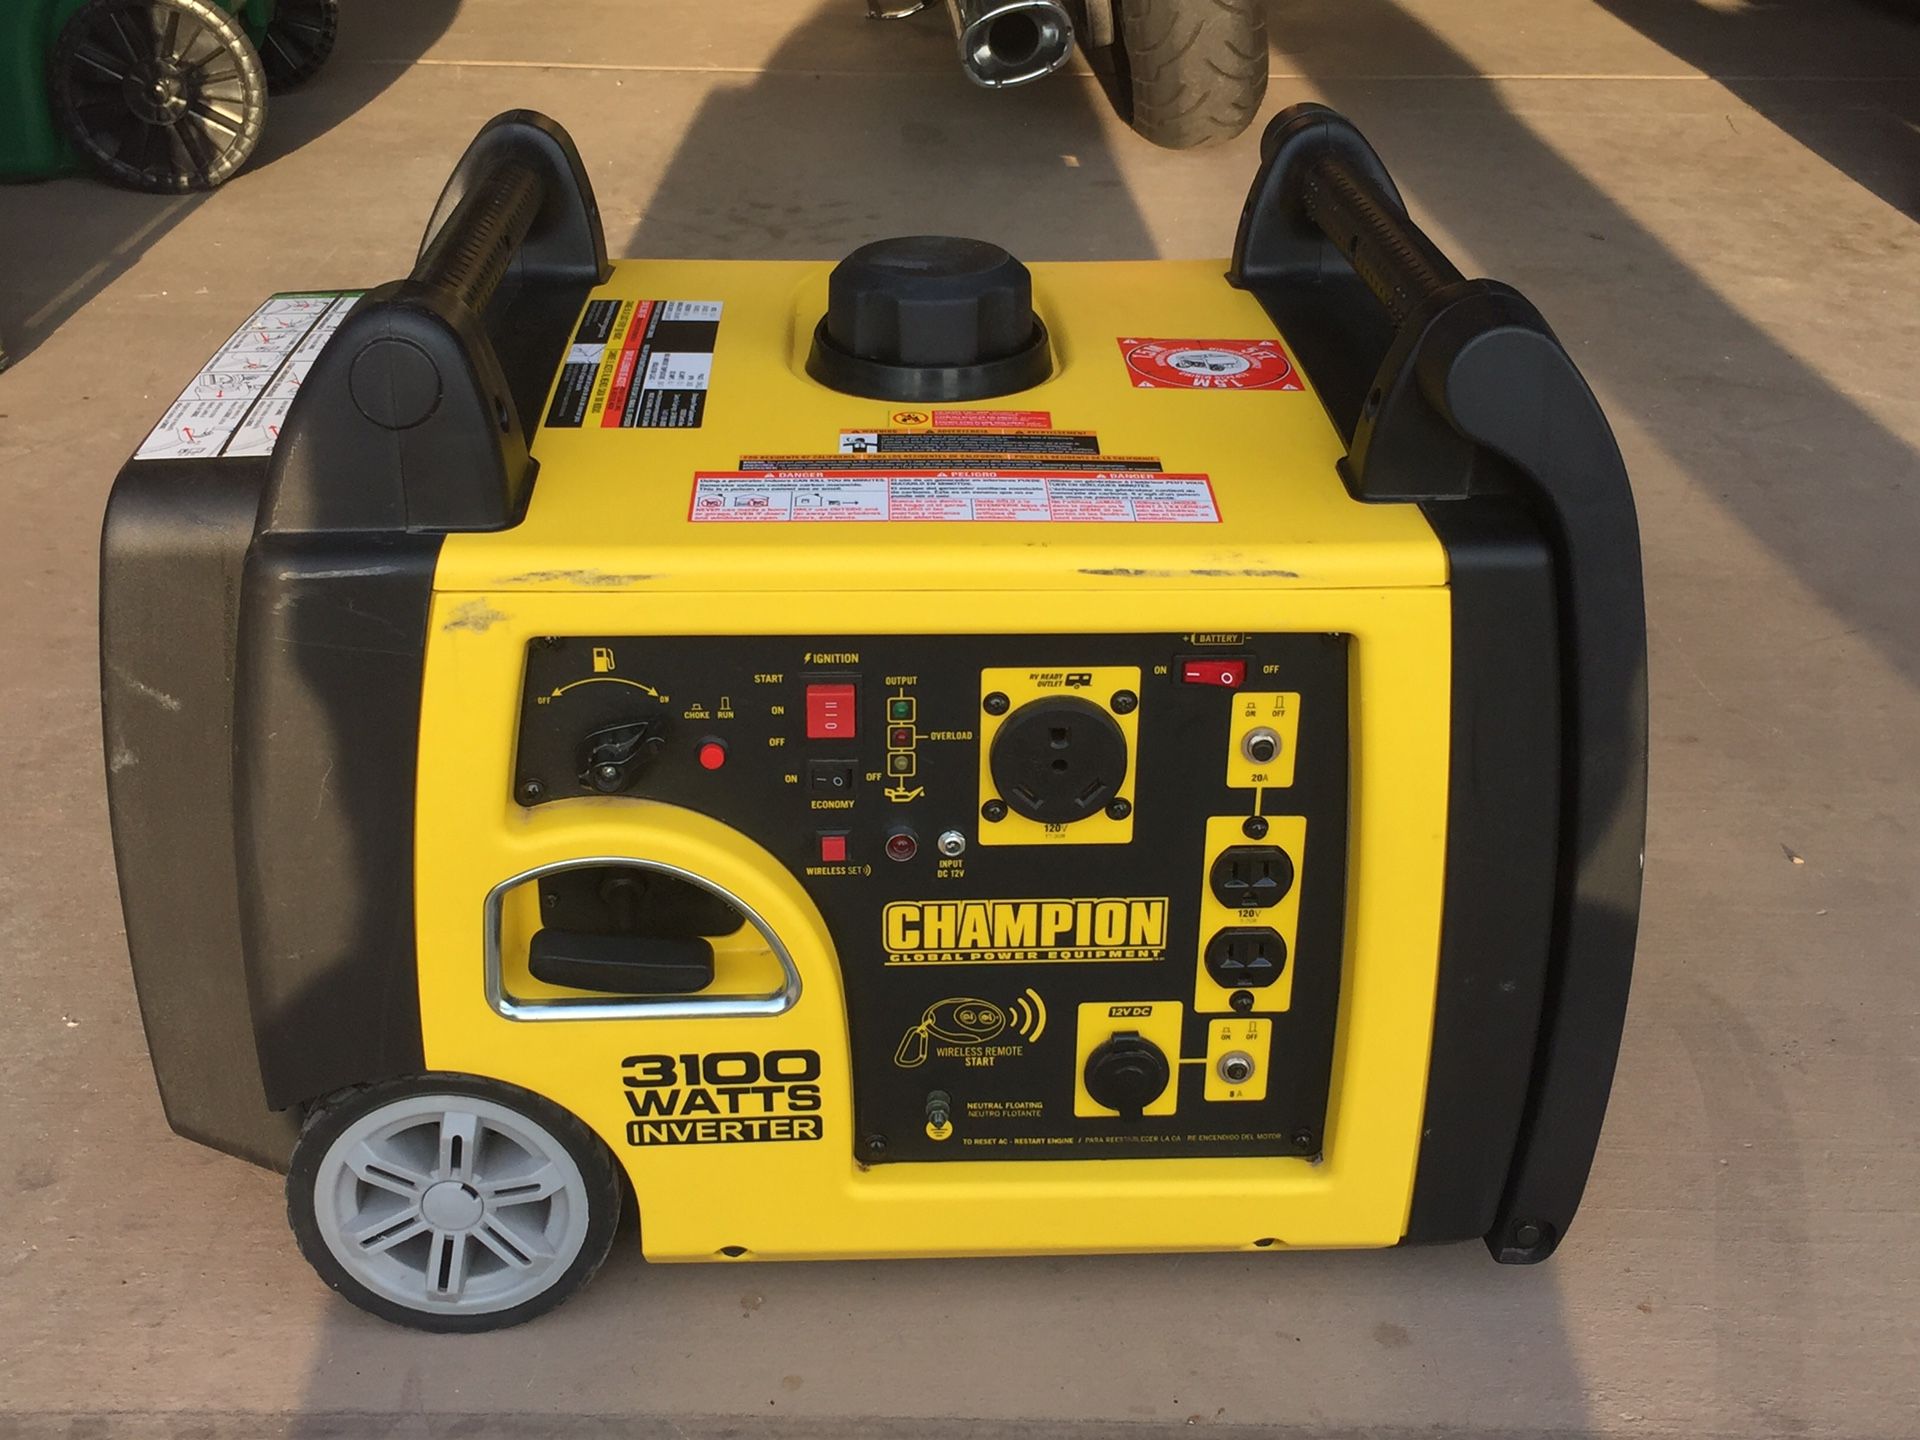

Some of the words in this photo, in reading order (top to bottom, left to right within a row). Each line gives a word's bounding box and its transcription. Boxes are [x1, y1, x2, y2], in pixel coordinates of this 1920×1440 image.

[1200, 634, 1238, 642] BATTERY
[814, 653, 860, 664] IGNITION
[1154, 666, 1168, 674] ON
[1263, 665, 1280, 674] OFF
[754, 674, 784, 684] START
[885, 676, 918, 686] OUTPUT
[538, 696, 551, 705] OFF
[684, 711, 710, 719] CHOKE
[717, 711, 734, 719] RUN
[771, 706, 784, 715] ON
[930, 732, 973, 740] OVERLOAD
[769, 738, 785, 747] OFF
[784, 774, 798, 784] ON
[866, 772, 882, 782] OFF
[1251, 774, 1268, 782] 20A
[811, 800, 855, 809] ECONOMY
[939, 860, 963, 868] INPUT
[806, 867, 846, 876] WIRELESS
[848, 866, 862, 875] SET
[937, 870, 950, 878] DC
[951, 870, 965, 878] 12V
[886, 900, 1165, 951] CHAMPION
[890, 953, 964, 962] GLOBAL
[970, 952, 1038, 960] POWER
[1048, 950, 1160, 960] EQUIPMENT
[1111, 1008, 1130, 1016] 12V
[1132, 1007, 1152, 1016] DC
[936, 1047, 983, 1056] WIRELESS
[985, 1046, 1023, 1056] REMOTE
[965, 1057, 995, 1066] START
[621, 1049, 822, 1088] 3100
[624, 1084, 822, 1116] WATTS
[632, 1118, 818, 1144] INVERTER
